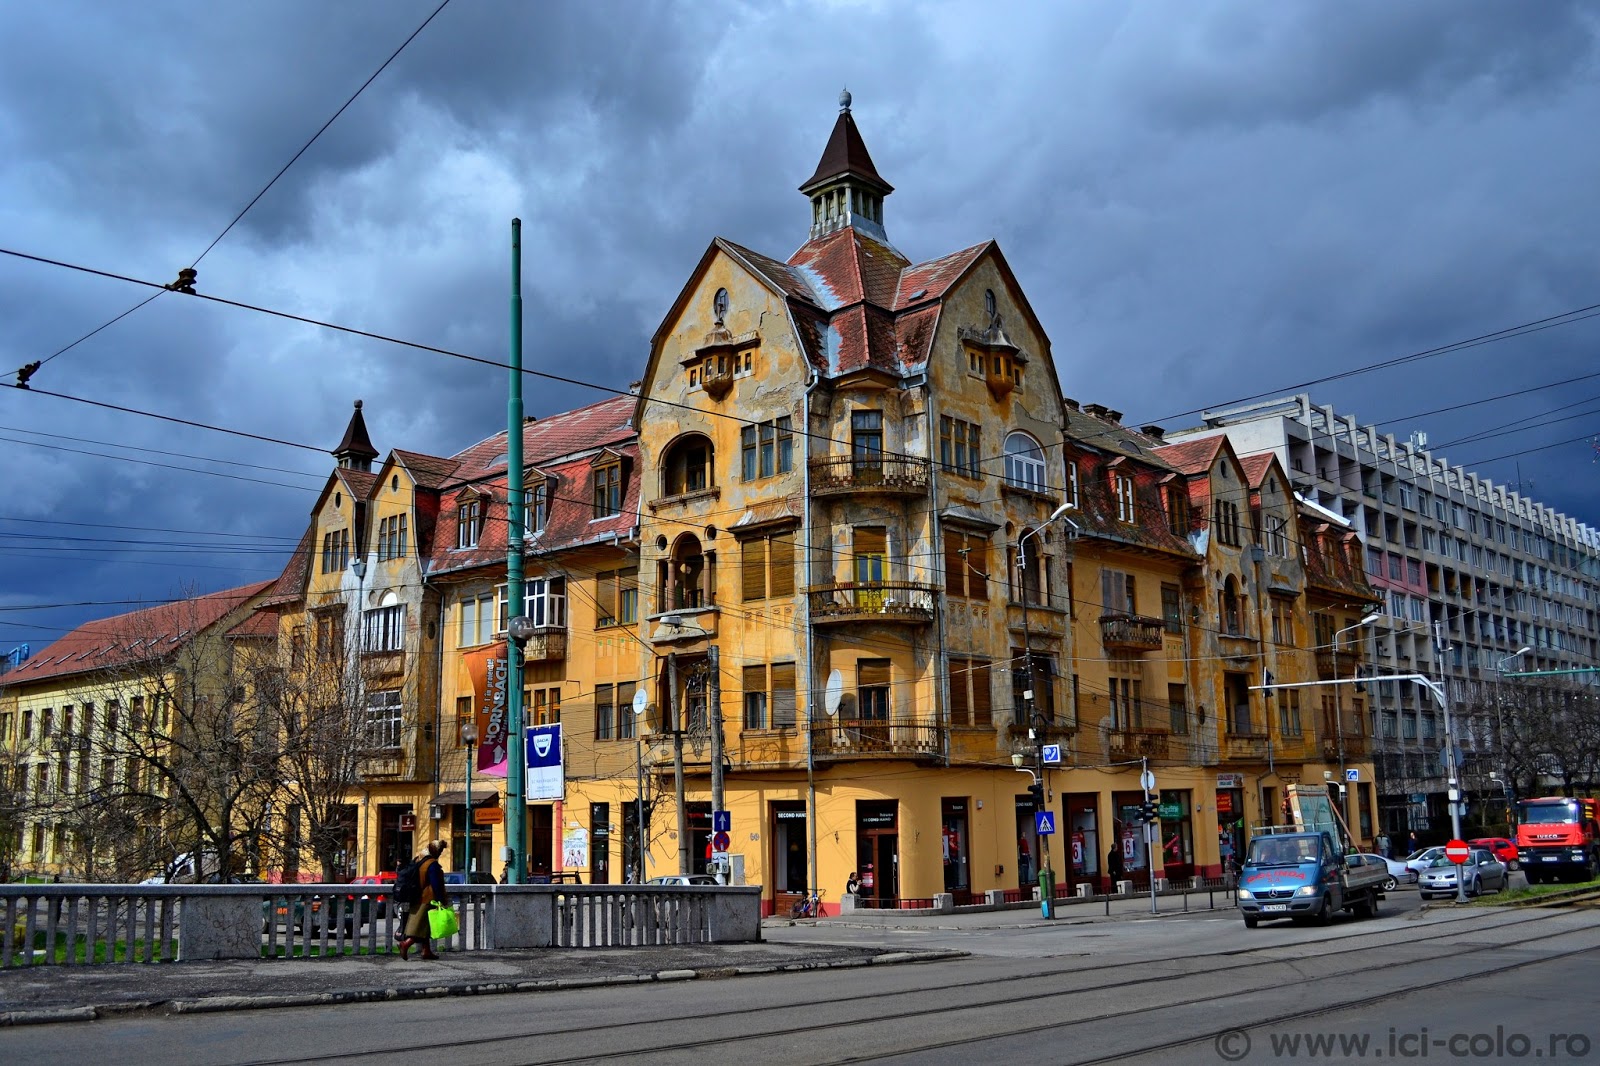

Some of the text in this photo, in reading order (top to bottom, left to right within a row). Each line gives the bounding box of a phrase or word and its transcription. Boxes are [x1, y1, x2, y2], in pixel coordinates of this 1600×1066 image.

[483, 659, 508, 745] HORNBACH
[1073, 843, 1079, 860] 6
[1125, 840, 1131, 855] 6
